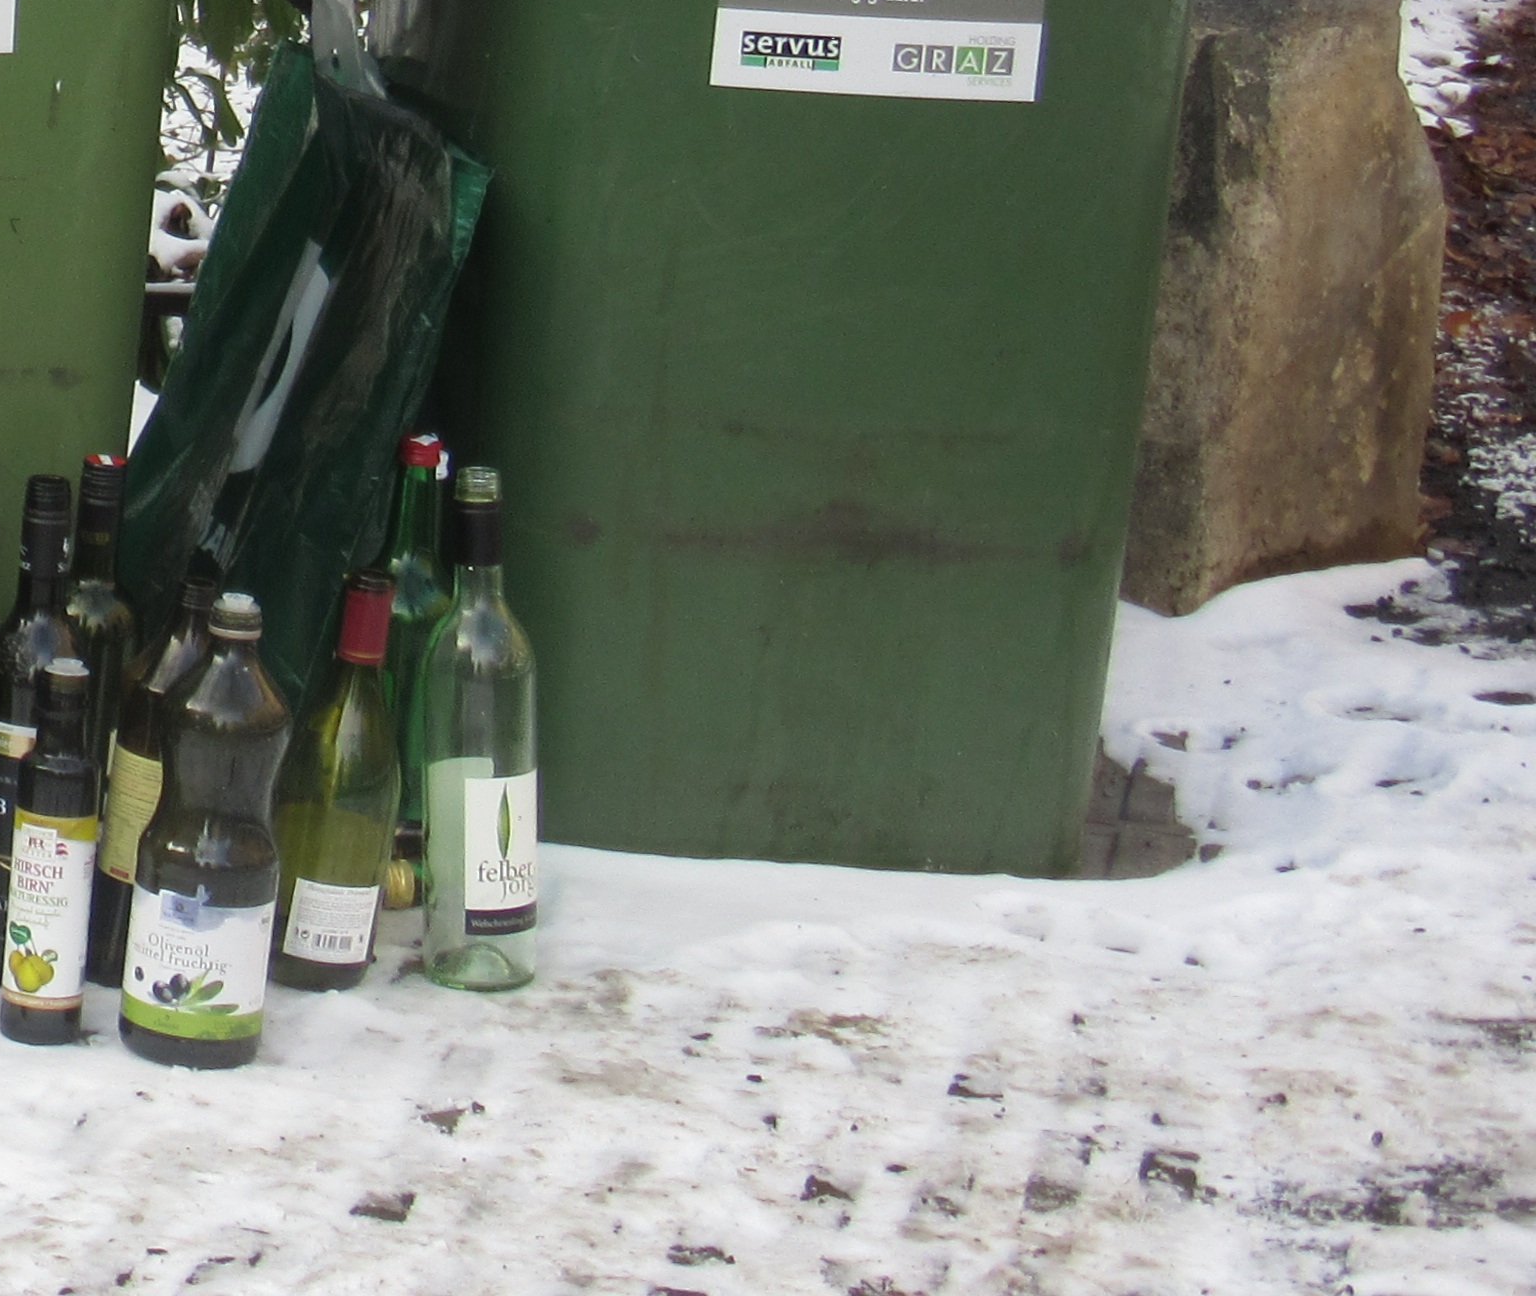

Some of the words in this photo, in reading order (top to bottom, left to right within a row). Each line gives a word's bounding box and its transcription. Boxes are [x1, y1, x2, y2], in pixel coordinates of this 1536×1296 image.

[743, 33, 840, 58] servus
[969, 35, 1016, 46] HOLDING
[768, 56, 812, 70] ABFALL
[893, 44, 1014, 75] GRAZ
[13, 857, 64, 880] HIRSCH
[147, 932, 210, 958] Olivenöl
[168, 952, 229, 975] fruchtig
